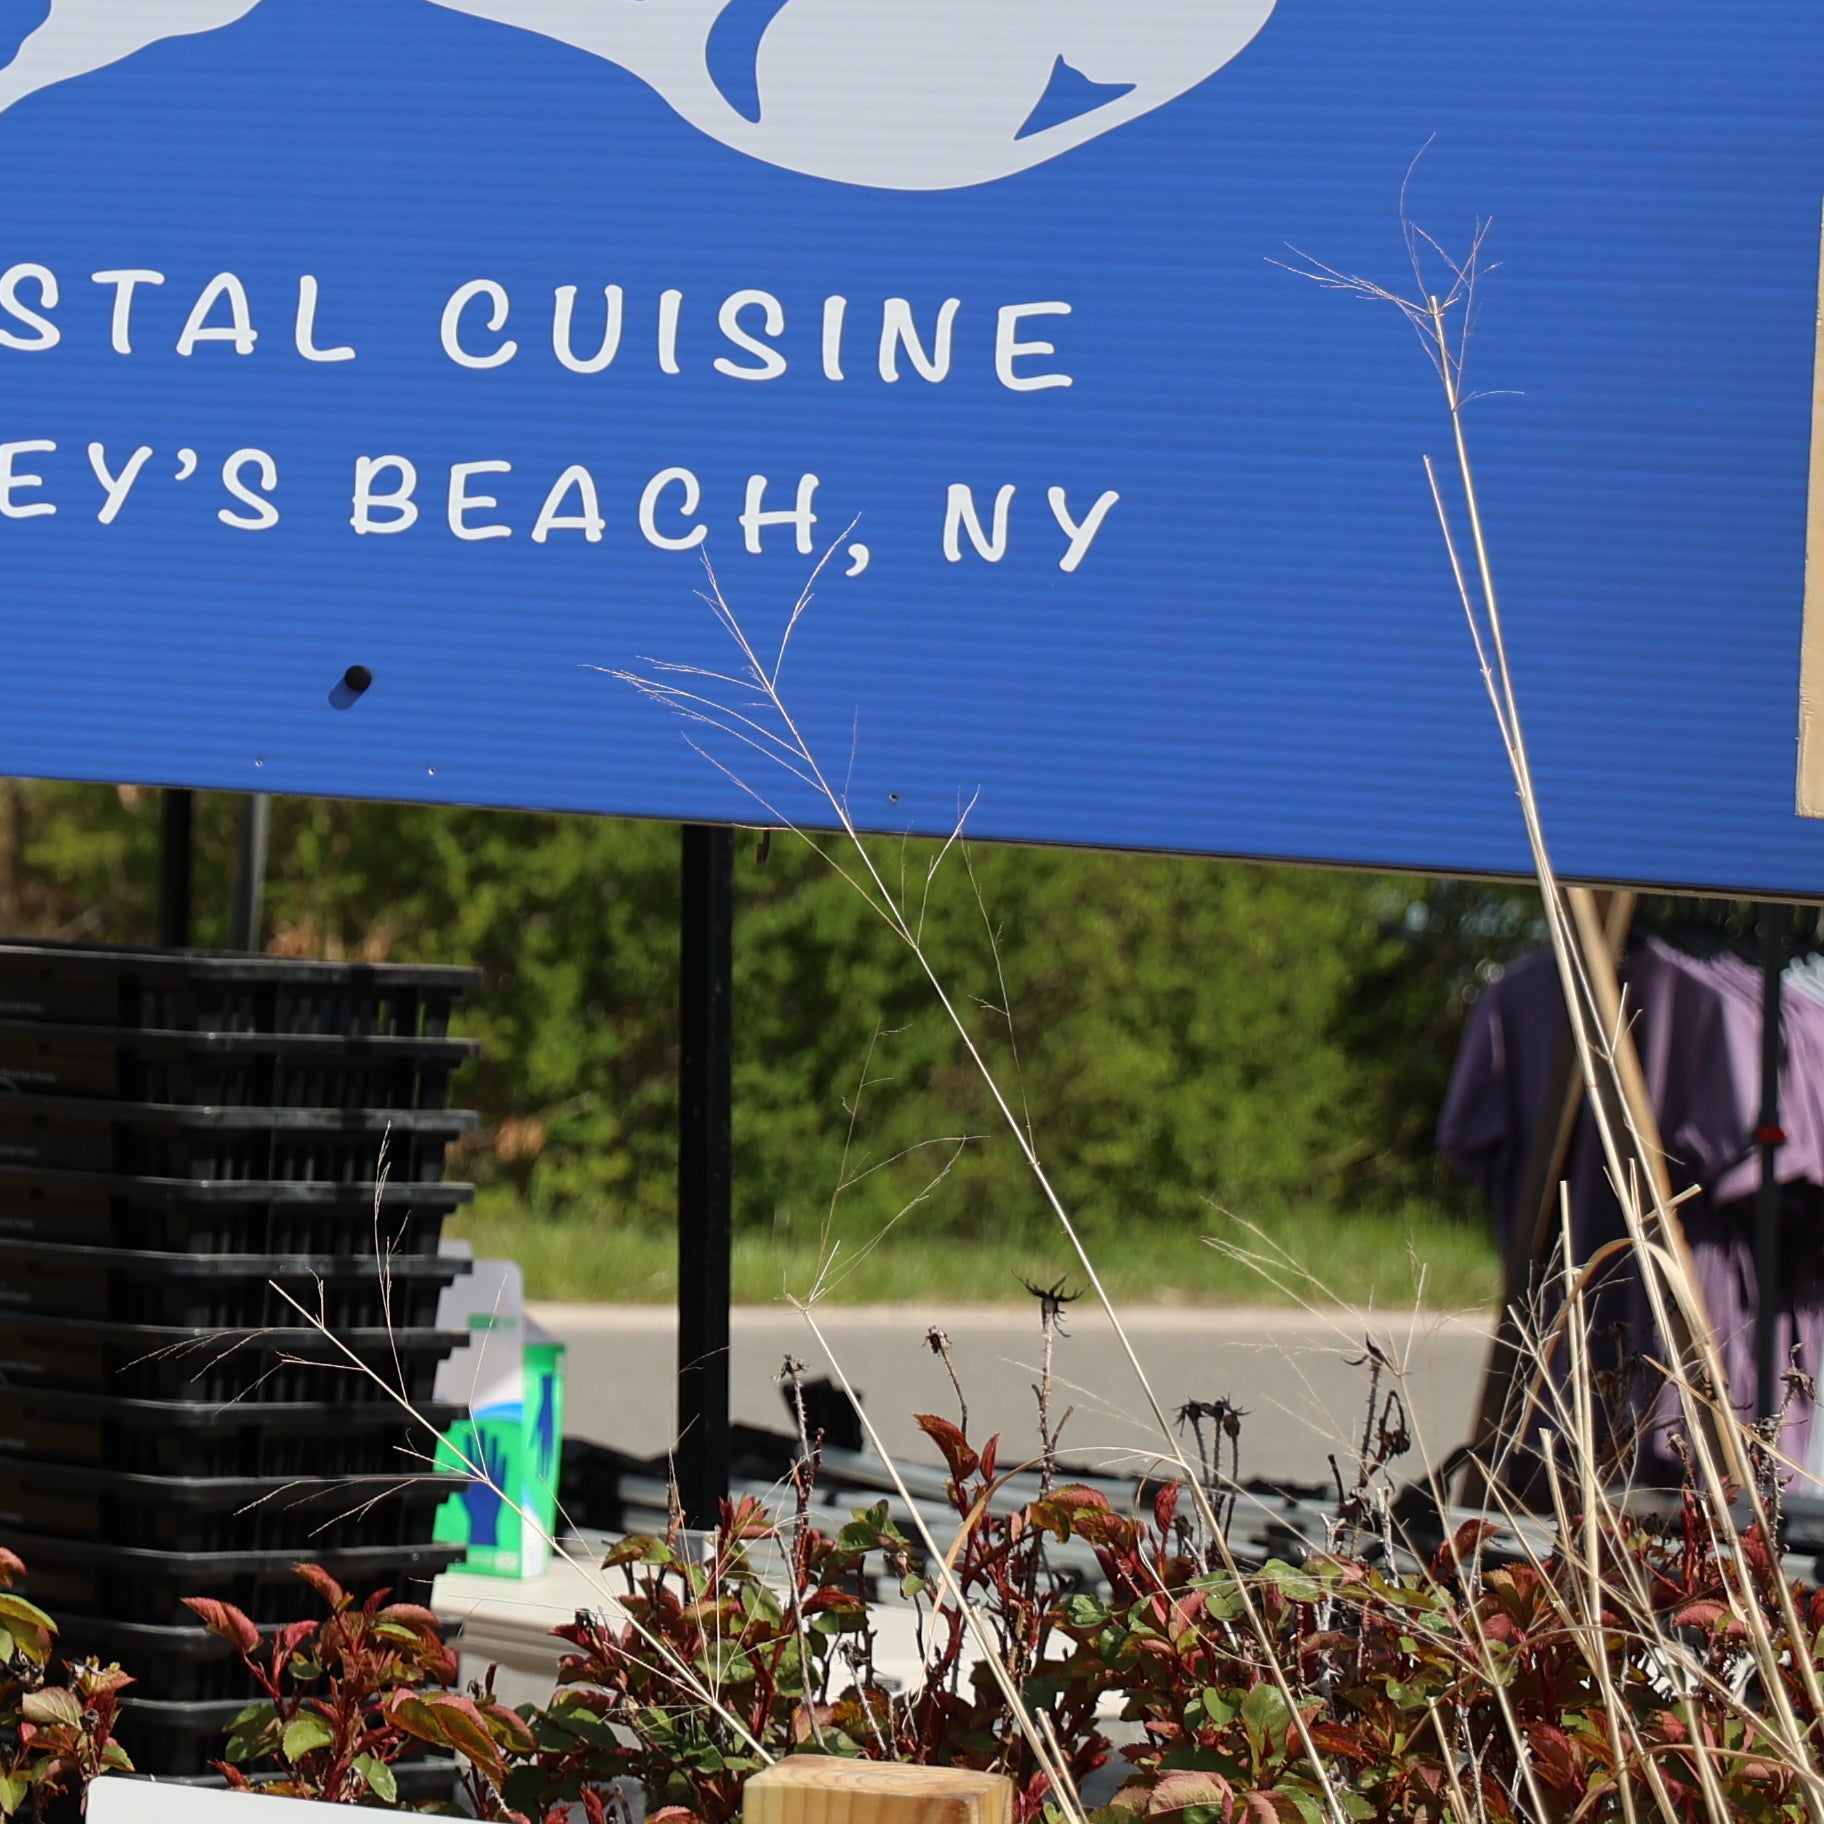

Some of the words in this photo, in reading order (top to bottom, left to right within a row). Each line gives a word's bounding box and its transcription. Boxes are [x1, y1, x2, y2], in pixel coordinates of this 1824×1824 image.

[439, 279, 1074, 392] CUISINE
[349, 454, 871, 577] BEACH,
[942, 483, 1121, 573] NY
